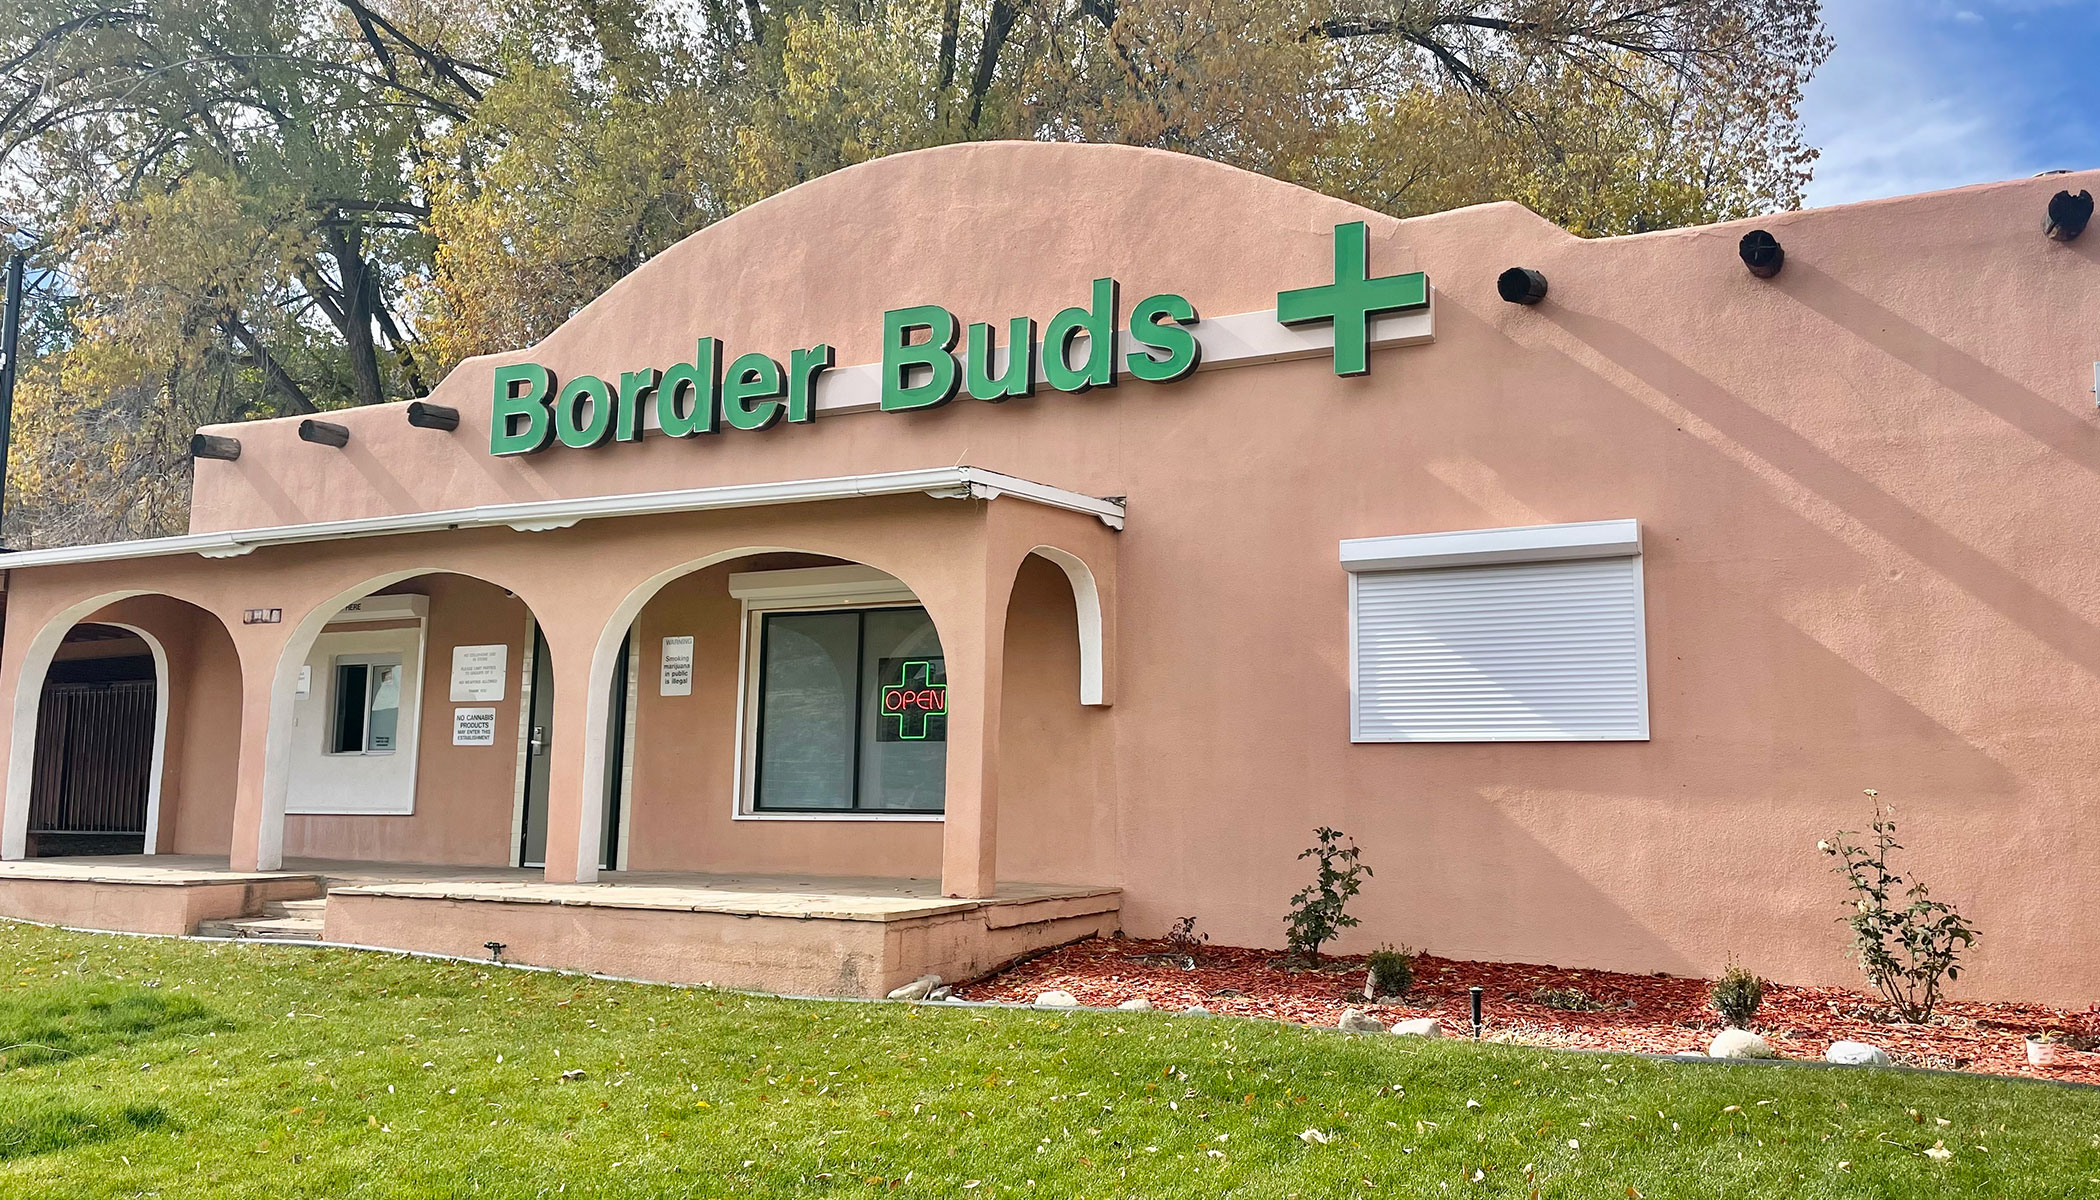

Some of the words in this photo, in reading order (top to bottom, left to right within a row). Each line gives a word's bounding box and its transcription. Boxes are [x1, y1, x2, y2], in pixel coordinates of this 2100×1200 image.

[490, 337, 834, 457] Border
[880, 277, 1201, 413] Buds
[885, 689, 945, 711] OPEN
